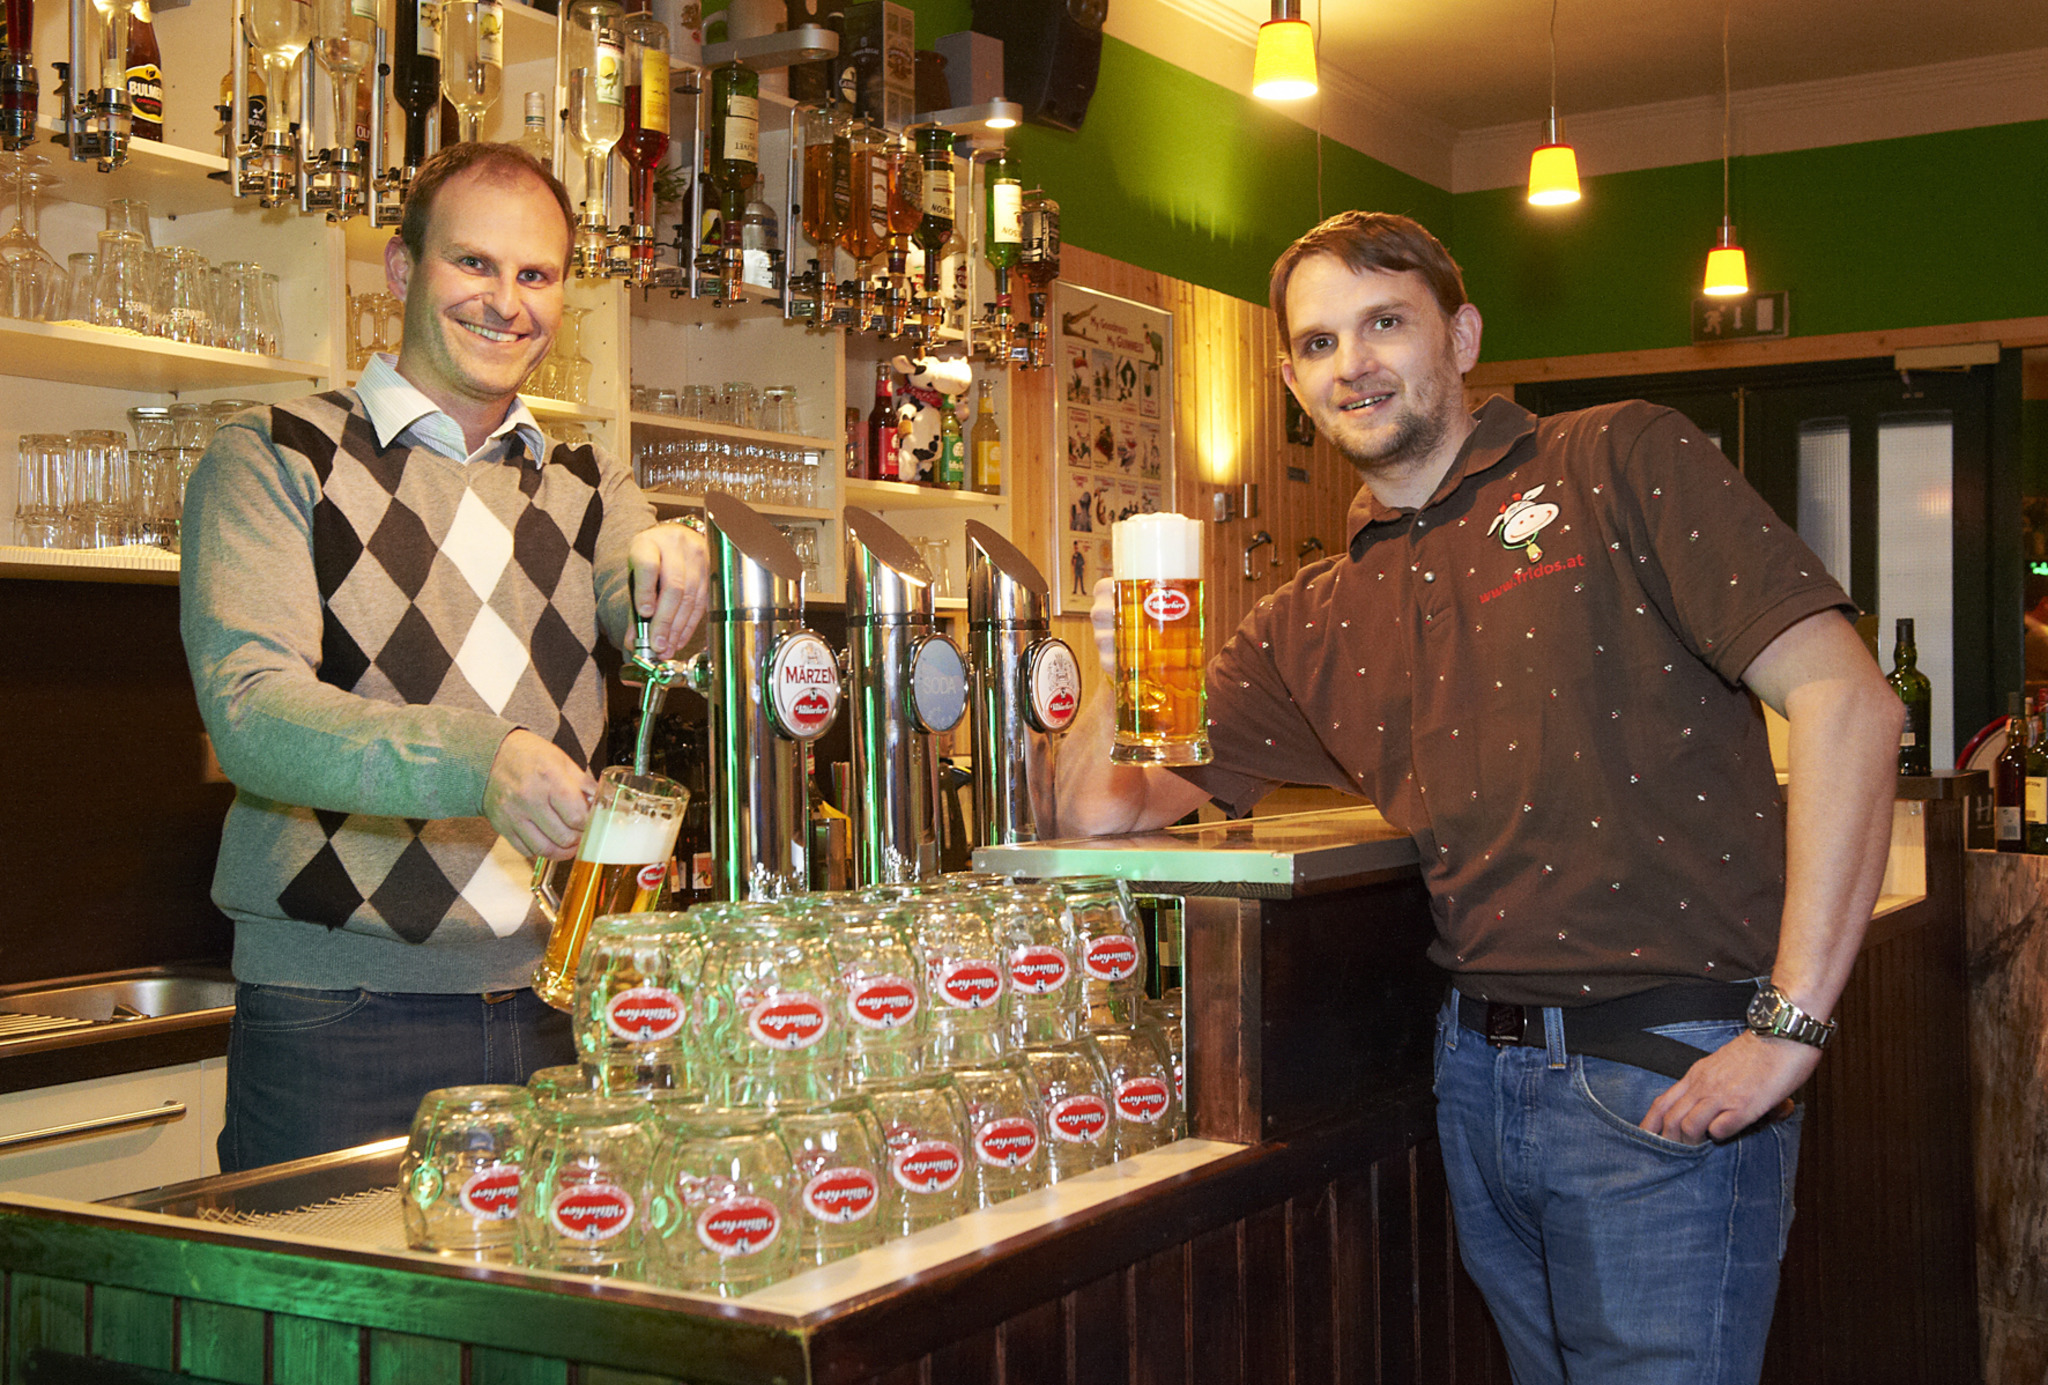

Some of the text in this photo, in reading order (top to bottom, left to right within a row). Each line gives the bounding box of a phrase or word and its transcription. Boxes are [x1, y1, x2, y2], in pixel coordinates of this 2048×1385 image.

[1479, 553, 1586, 604] www.fridos.at
[785, 665, 836, 684] MÄRZEN
[923, 676, 957, 695] SODA
